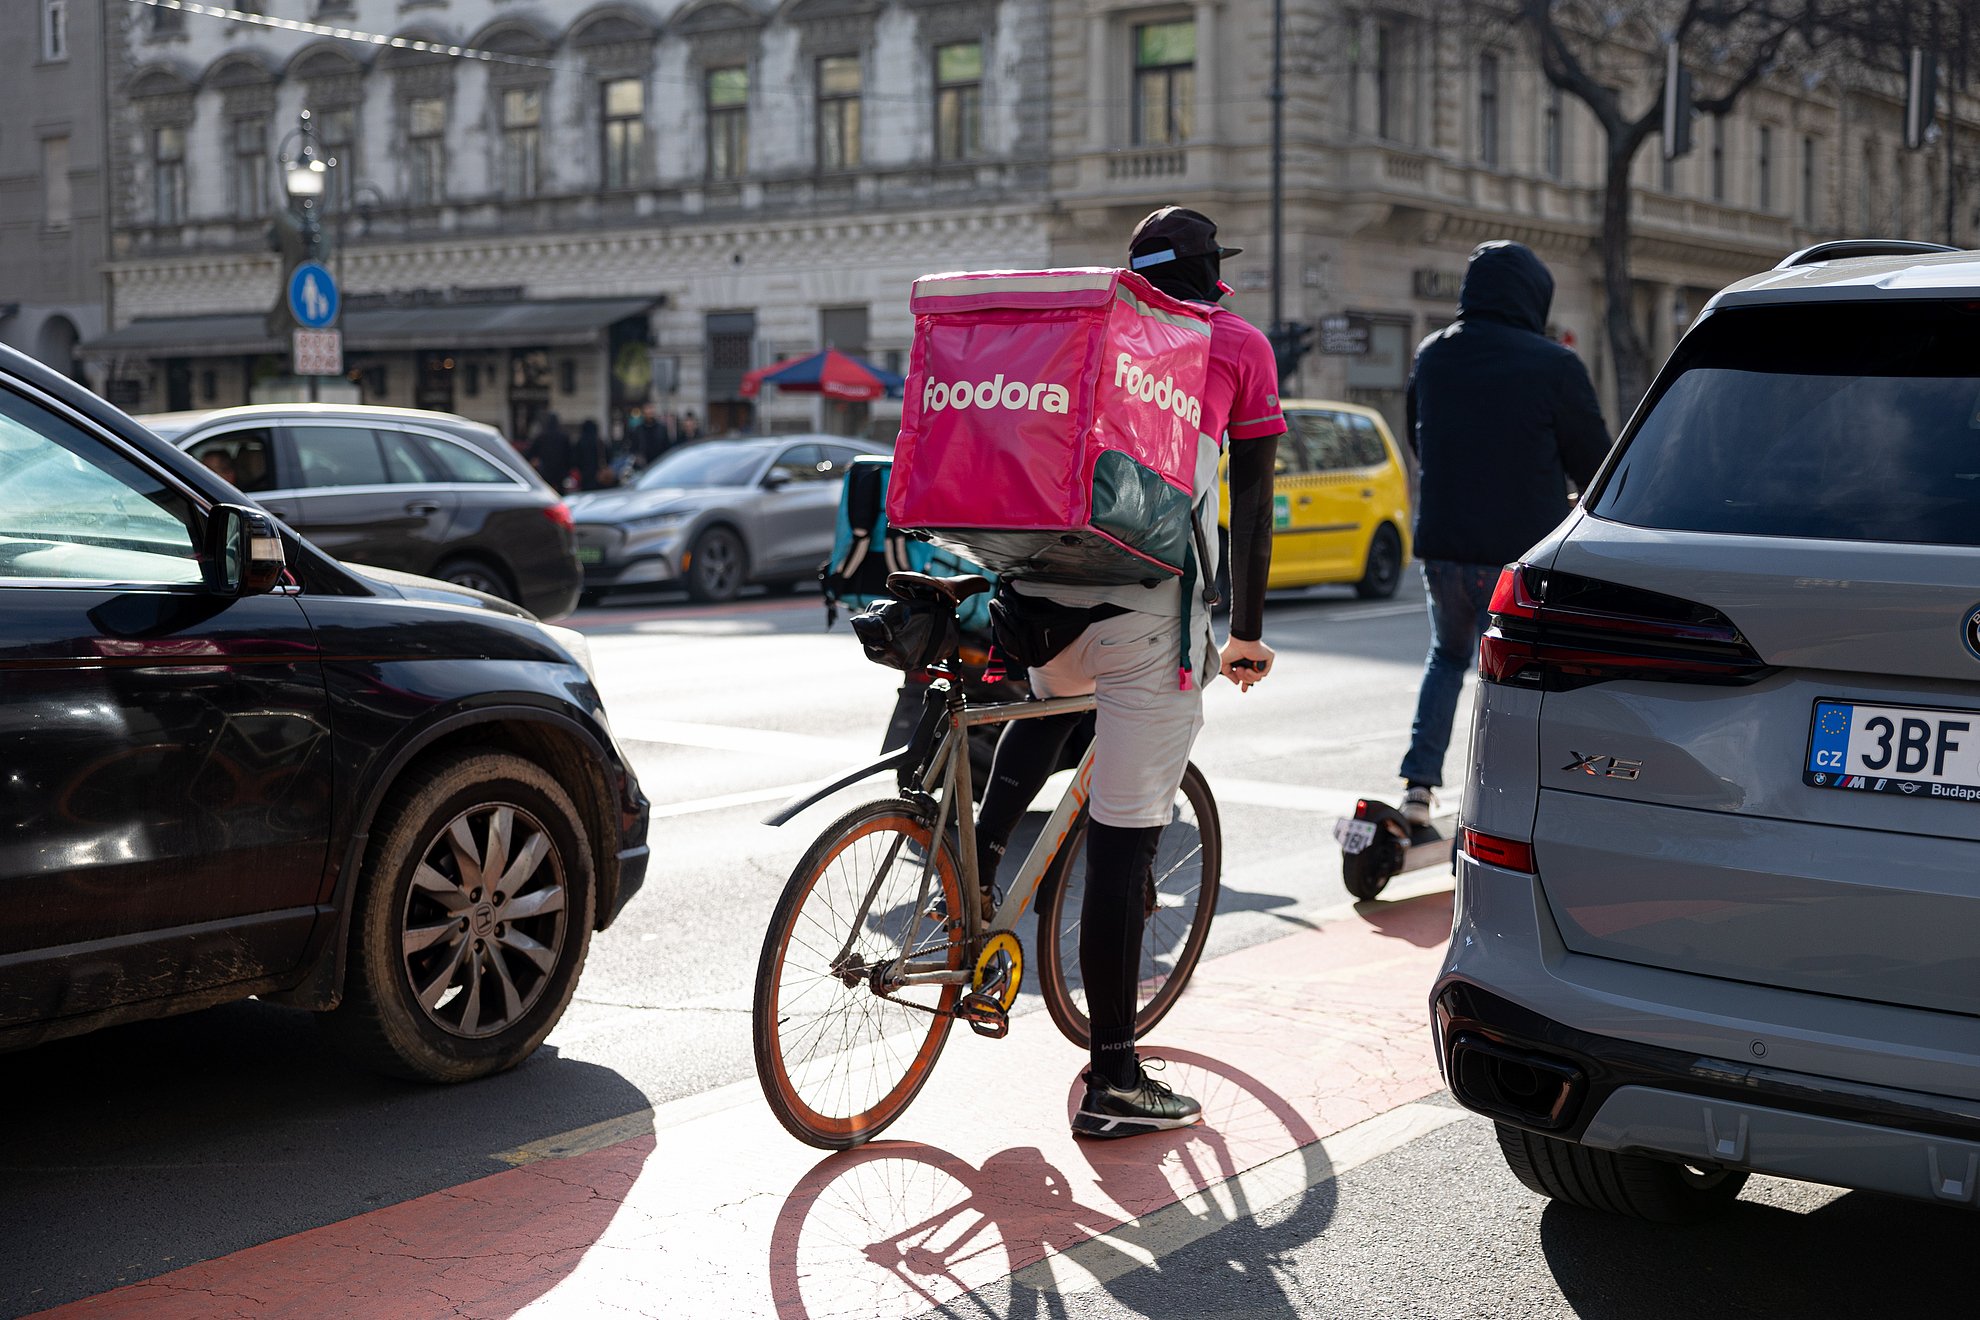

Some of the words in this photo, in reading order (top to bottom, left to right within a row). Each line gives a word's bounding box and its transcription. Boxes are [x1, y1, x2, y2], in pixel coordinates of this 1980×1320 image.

[923, 374, 1070, 415] foodora
[1114, 352, 1202, 430] foodora
[1561, 750, 1643, 780] X5
[1816, 750, 1843, 767] CZ
[1861, 716, 1970, 775] 3BF
